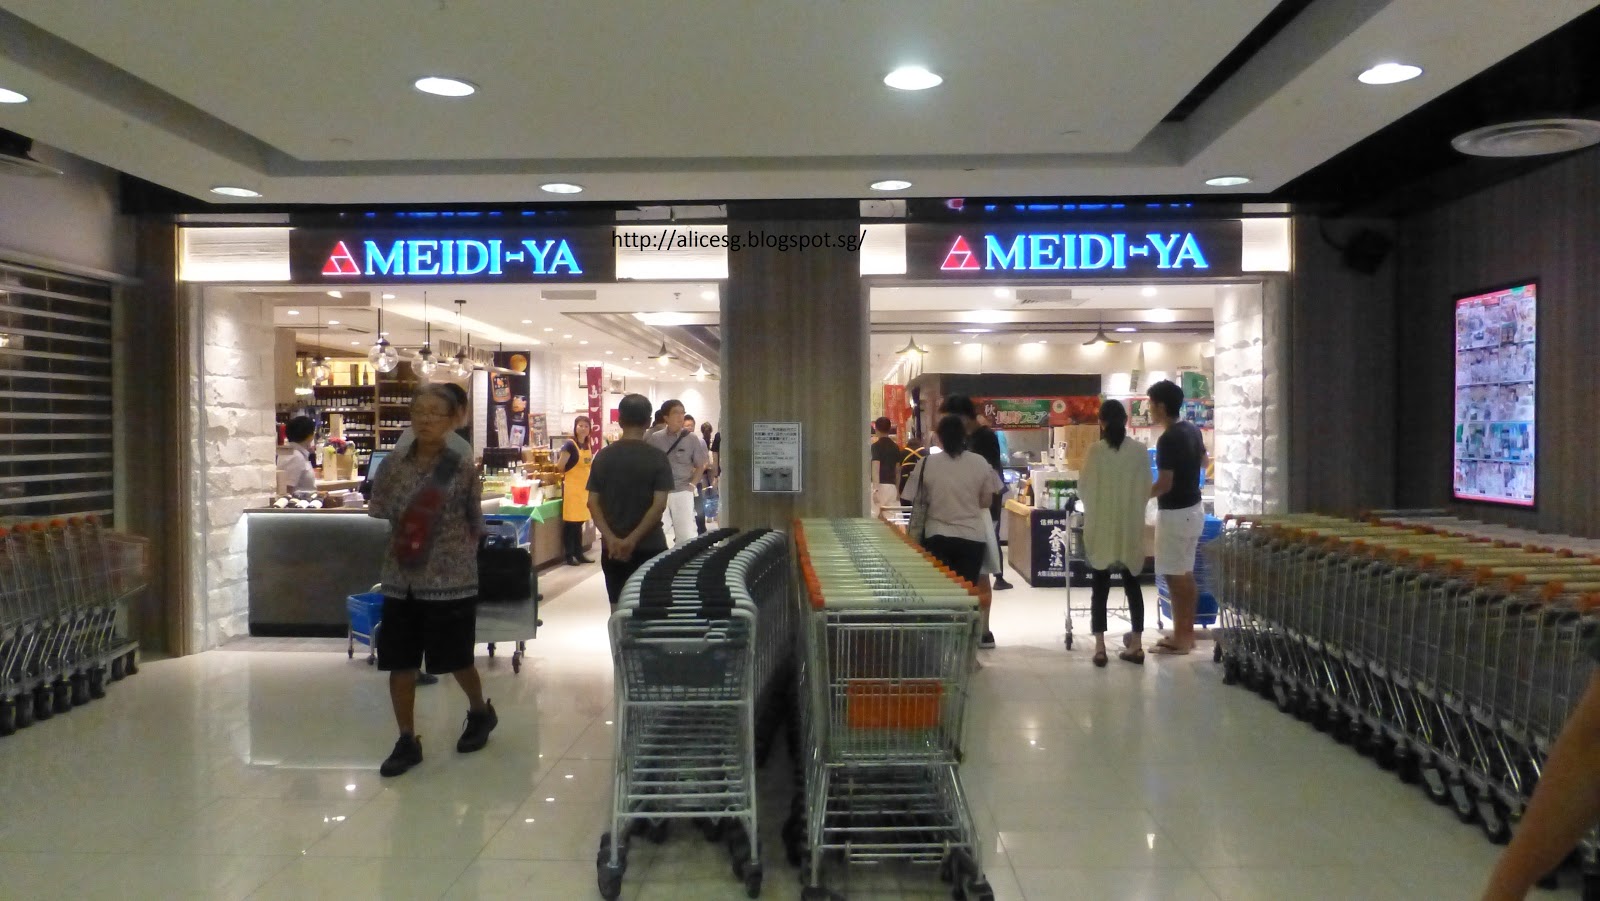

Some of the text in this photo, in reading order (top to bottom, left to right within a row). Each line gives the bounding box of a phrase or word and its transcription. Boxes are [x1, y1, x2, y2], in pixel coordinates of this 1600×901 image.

[364, 239, 583, 275] MEIDI-YA
[984, 233, 1209, 270] MEIDI-YA
[984, 404, 996, 416] 秋
